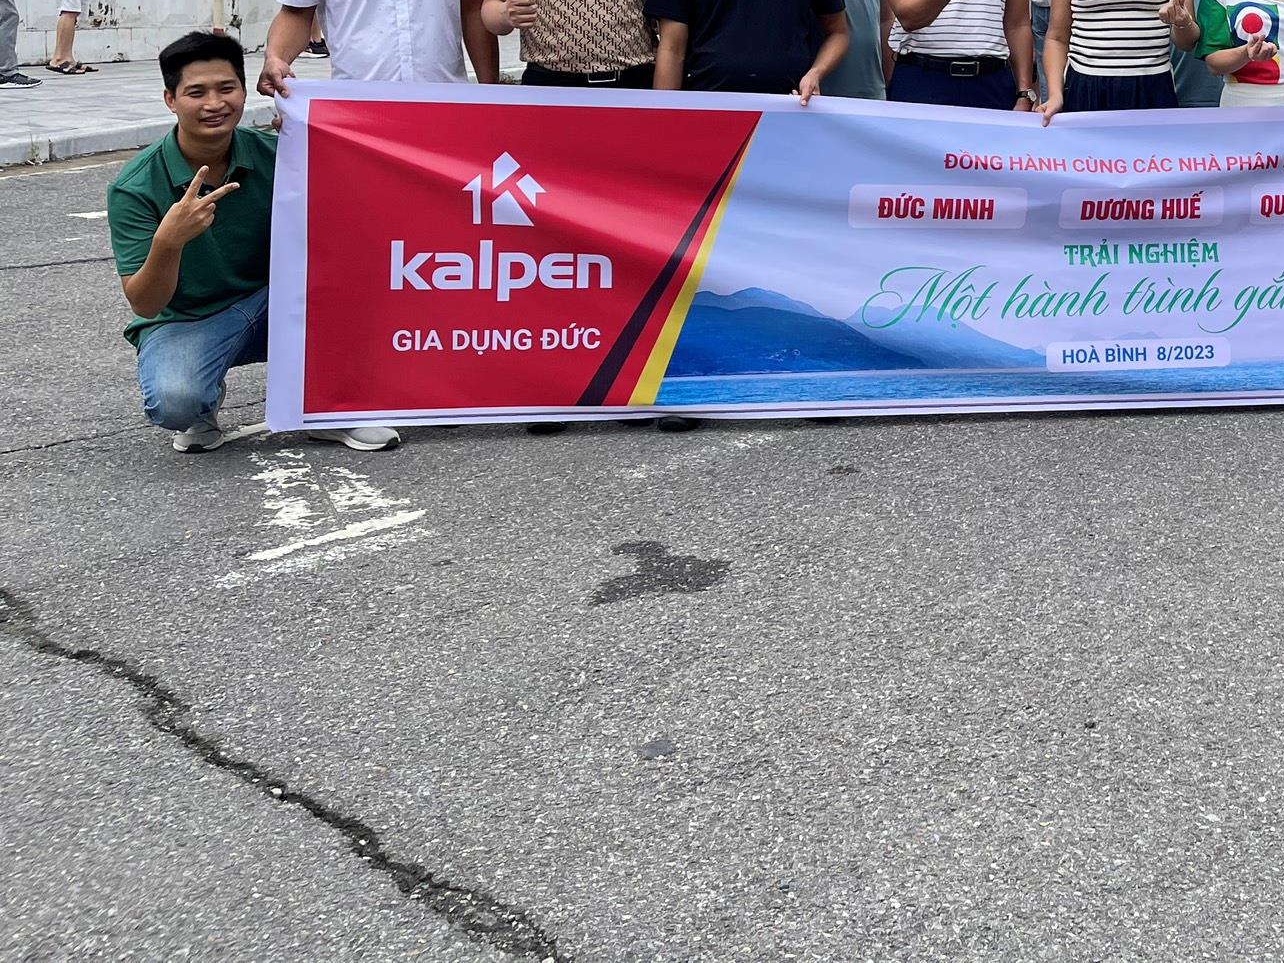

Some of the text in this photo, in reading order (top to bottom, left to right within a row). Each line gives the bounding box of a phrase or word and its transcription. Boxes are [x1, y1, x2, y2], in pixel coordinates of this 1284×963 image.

[943, 148, 1004, 171] ĐỒNG
[1009, 153, 1067, 173] HÀNH
[1072, 155, 1128, 175] CÙNG
[1132, 153, 1174, 174] CÁC
[1178, 152, 1221, 173] NHÀ
[1226, 150, 1279, 172] PHÂN
[877, 192, 995, 221] ĐỨC MINH
[1080, 190, 1204, 221] DƯƠNG HUẾ
[1064, 237, 1221, 269] TRẢI NGHIỆM
[390, 239, 613, 302] kalpen
[861, 265, 1000, 330] Một
[1001, 271, 1113, 321] hành
[1122, 267, 1225, 316] trình
[392, 323, 601, 356] GIA DỤNG ĐỨC
[1062, 343, 1216, 365] HOÀ BÌNH 8/2023
